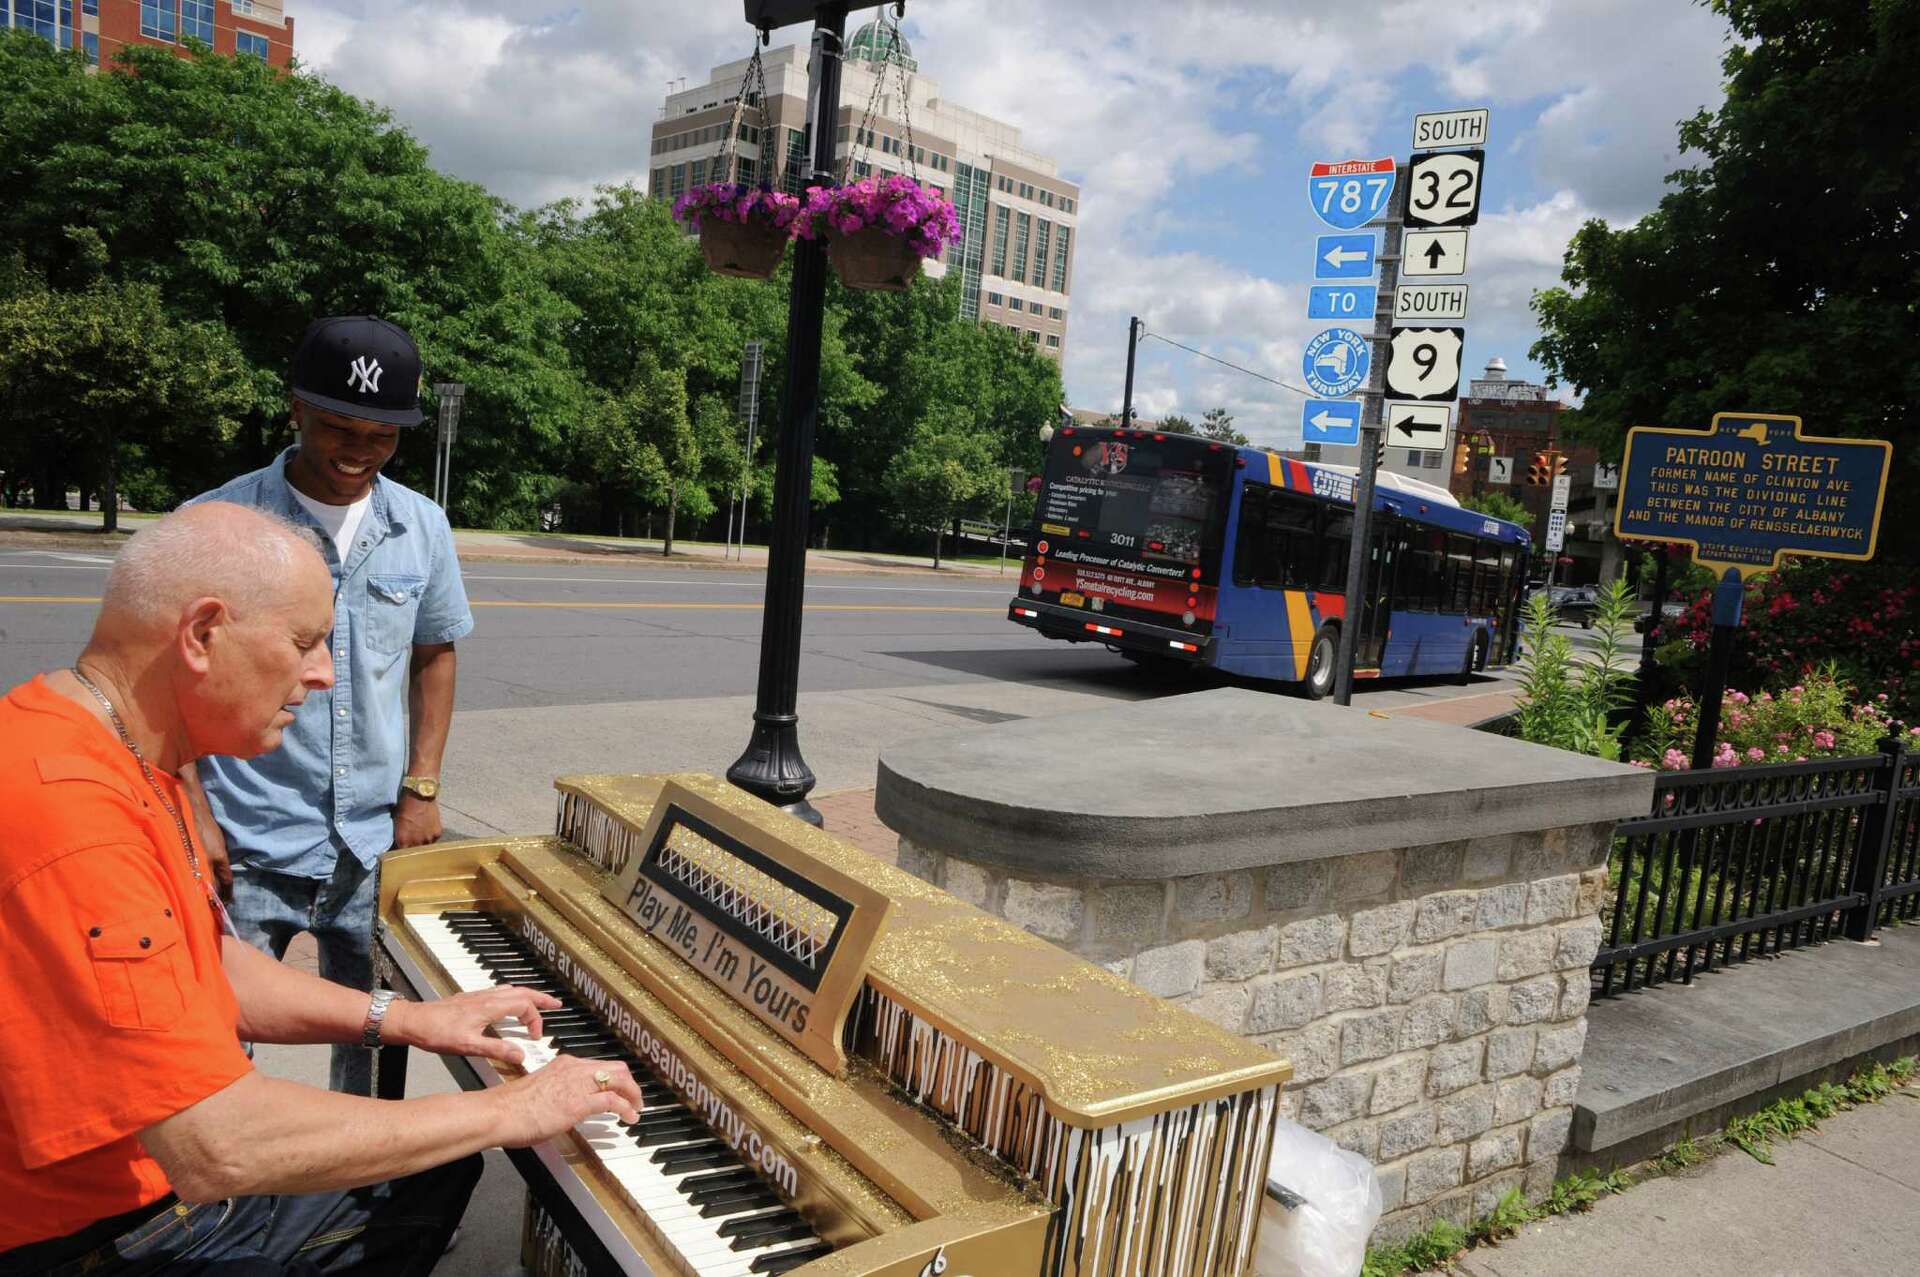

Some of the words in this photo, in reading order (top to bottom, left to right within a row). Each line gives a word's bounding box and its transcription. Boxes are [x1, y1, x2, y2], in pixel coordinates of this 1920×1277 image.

[1419, 116, 1483, 142] SOUTH
[1329, 161, 1377, 175] INTERSTATE
[1318, 177, 1388, 214] 787
[1413, 168, 1474, 211] 32
[1328, 292, 1356, 313] TO
[1400, 291, 1463, 313] SOUTH
[1305, 331, 1330, 357] NEW
[1338, 330, 1366, 356] YORK
[347, 355, 384, 394] NY
[1412, 343, 1438, 382] 9
[1307, 370, 1362, 396] THRUWAY
[1665, 446, 1746, 469] PATROON
[1761, 452, 1841, 475] STREET
[1650, 466, 1697, 481] FORMER
[1704, 470, 1737, 483] NAME
[1743, 472, 1760, 485] OF
[1765, 474, 1820, 490] CLINTON
[1649, 481, 1679, 494] THIS
[1684, 483, 1709, 496] WAS
[1715, 486, 1739, 499] THE
[1746, 489, 1807, 505] DIVIDING
[1816, 494, 1849, 508] LINE
[1647, 497, 1701, 511] BETWEEN
[1708, 501, 1732, 514] THE
[1739, 503, 1767, 517] CITY
[1772, 506, 1789, 519] OF
[1795, 508, 1846, 523] ALBANY
[1627, 509, 1651, 522] AND
[1657, 511, 1680, 524] THE
[1684, 513, 1725, 527] MANOR
[1730, 518, 1747, 530] OF
[1749, 519, 1864, 540] RENSSELAERWYCK
[1110, 532, 1135, 547] 3011
[1055, 548, 1079, 560] Leading
[1118, 559, 1145, 572] Catalytic
[1146, 564, 1186, 578] Converters!
[625, 876, 669, 931] Play
[666, 904, 698, 960] Me,
[703, 931, 740, 982] I'm
[742, 956, 810, 1033] Yours
[522, 914, 556, 962] Share
[558, 951, 573, 978] at
[572, 966, 800, 1198] www.pianosalbanyny.com
